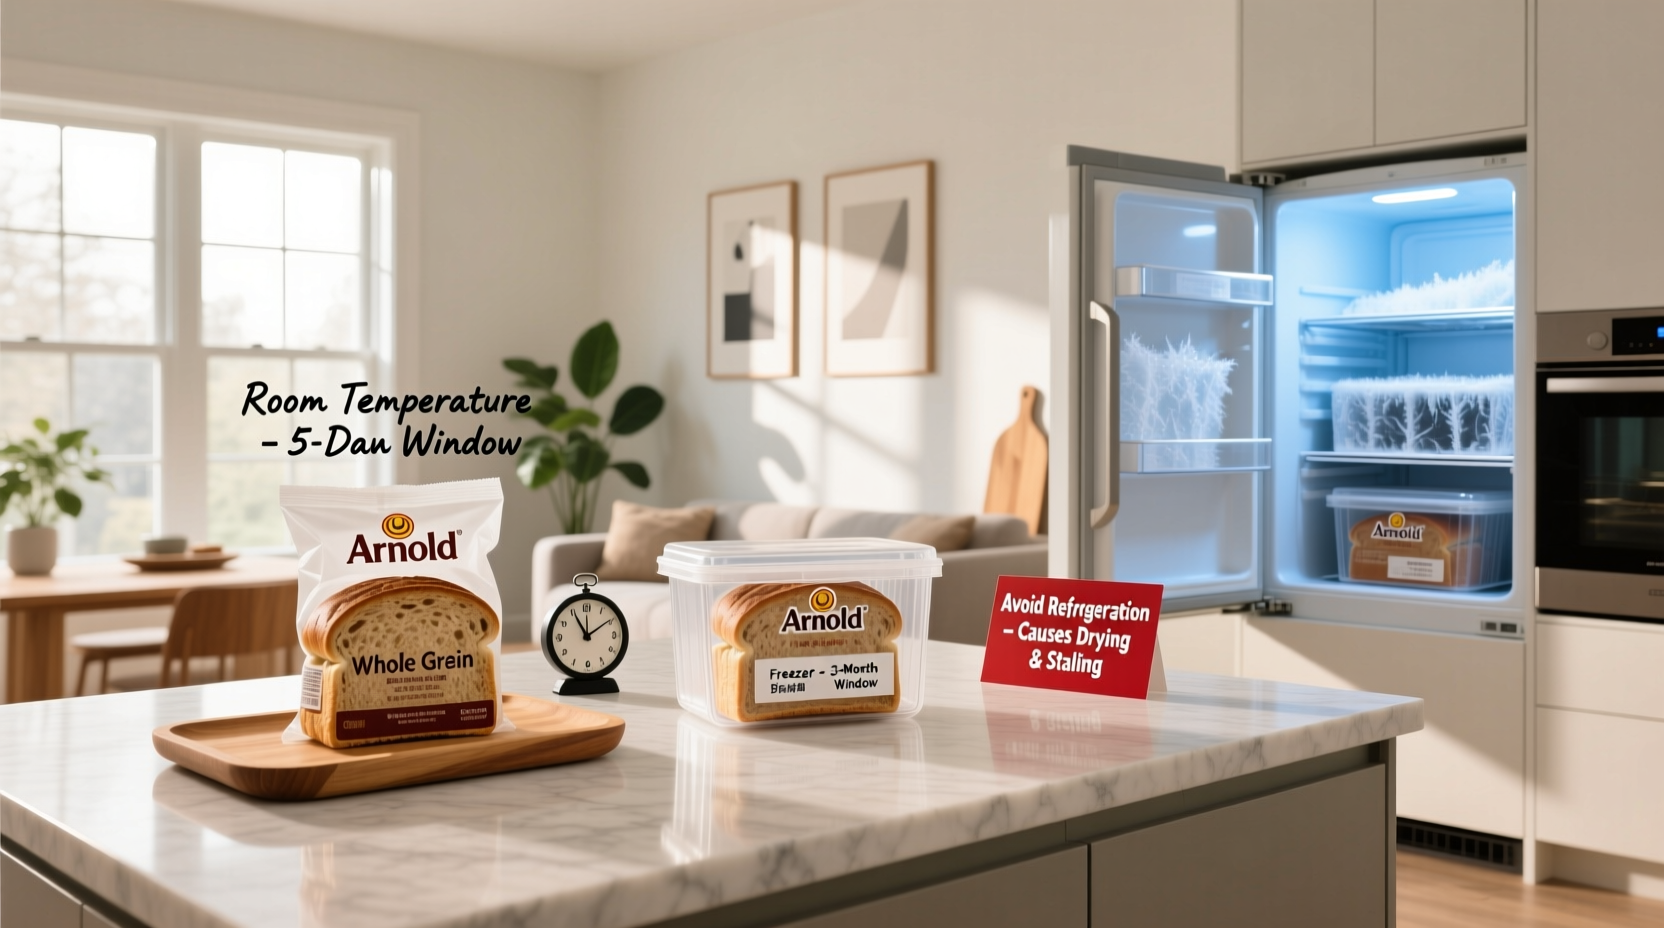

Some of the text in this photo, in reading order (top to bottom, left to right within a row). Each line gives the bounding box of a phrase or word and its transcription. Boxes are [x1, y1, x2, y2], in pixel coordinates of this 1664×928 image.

[346, 531, 458, 564] Arnold
[1000, 592, 1046, 615] Avoid
[781, 607, 863, 632] Arnold
[1018, 621, 1073, 644] Causes
[1076, 626, 1132, 655] Drying
[352, 652, 416, 676] Whole
[770, 668, 815, 680] Freezer
[1028, 648, 1104, 679] & Staling
[834, 677, 878, 690] Window
